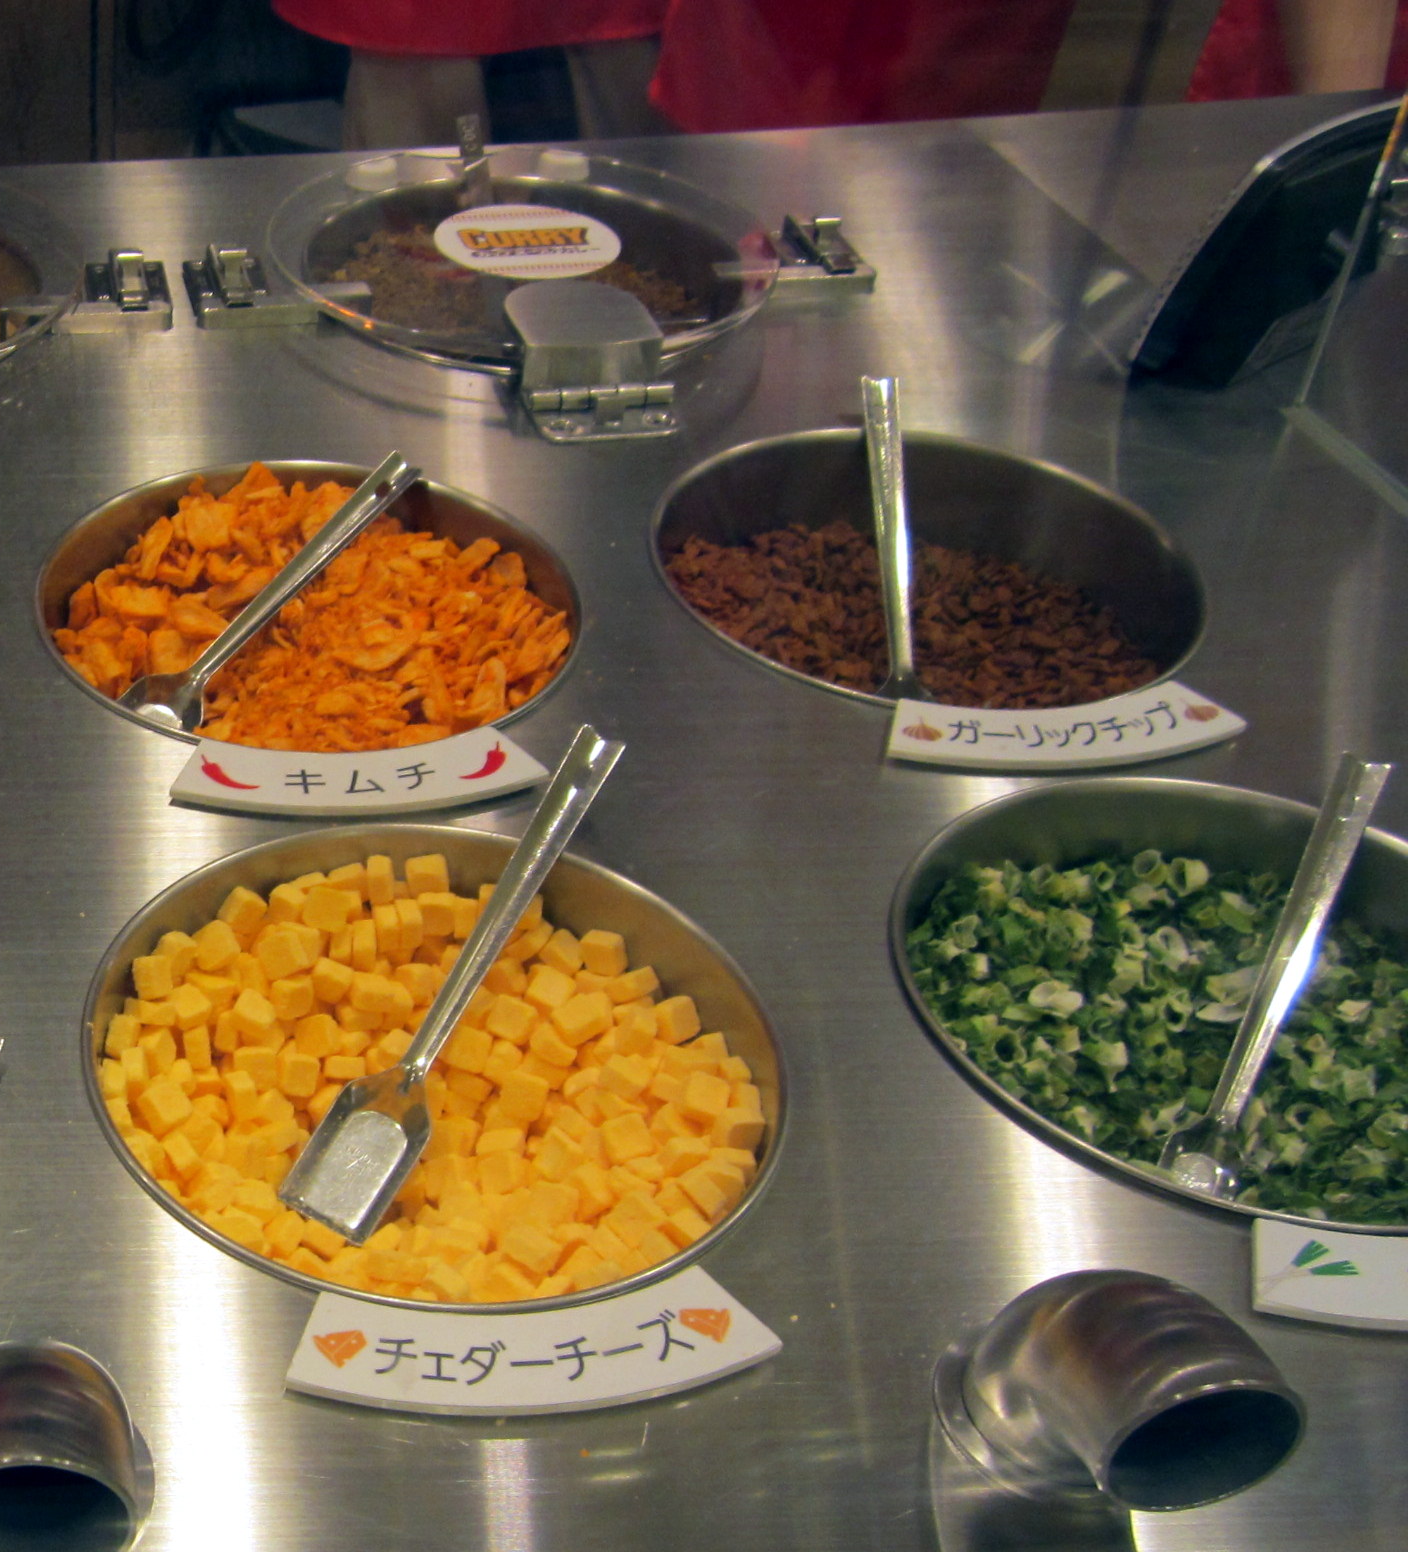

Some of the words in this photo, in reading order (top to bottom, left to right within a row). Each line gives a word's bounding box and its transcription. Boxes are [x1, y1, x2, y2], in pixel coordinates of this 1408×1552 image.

[457, 226, 588, 250] CURRY
[948, 700, 1177, 748] ガーリックチップ
[285, 762, 435, 794] キムチ
[374, 1309, 695, 1385] チェダーチーズ
